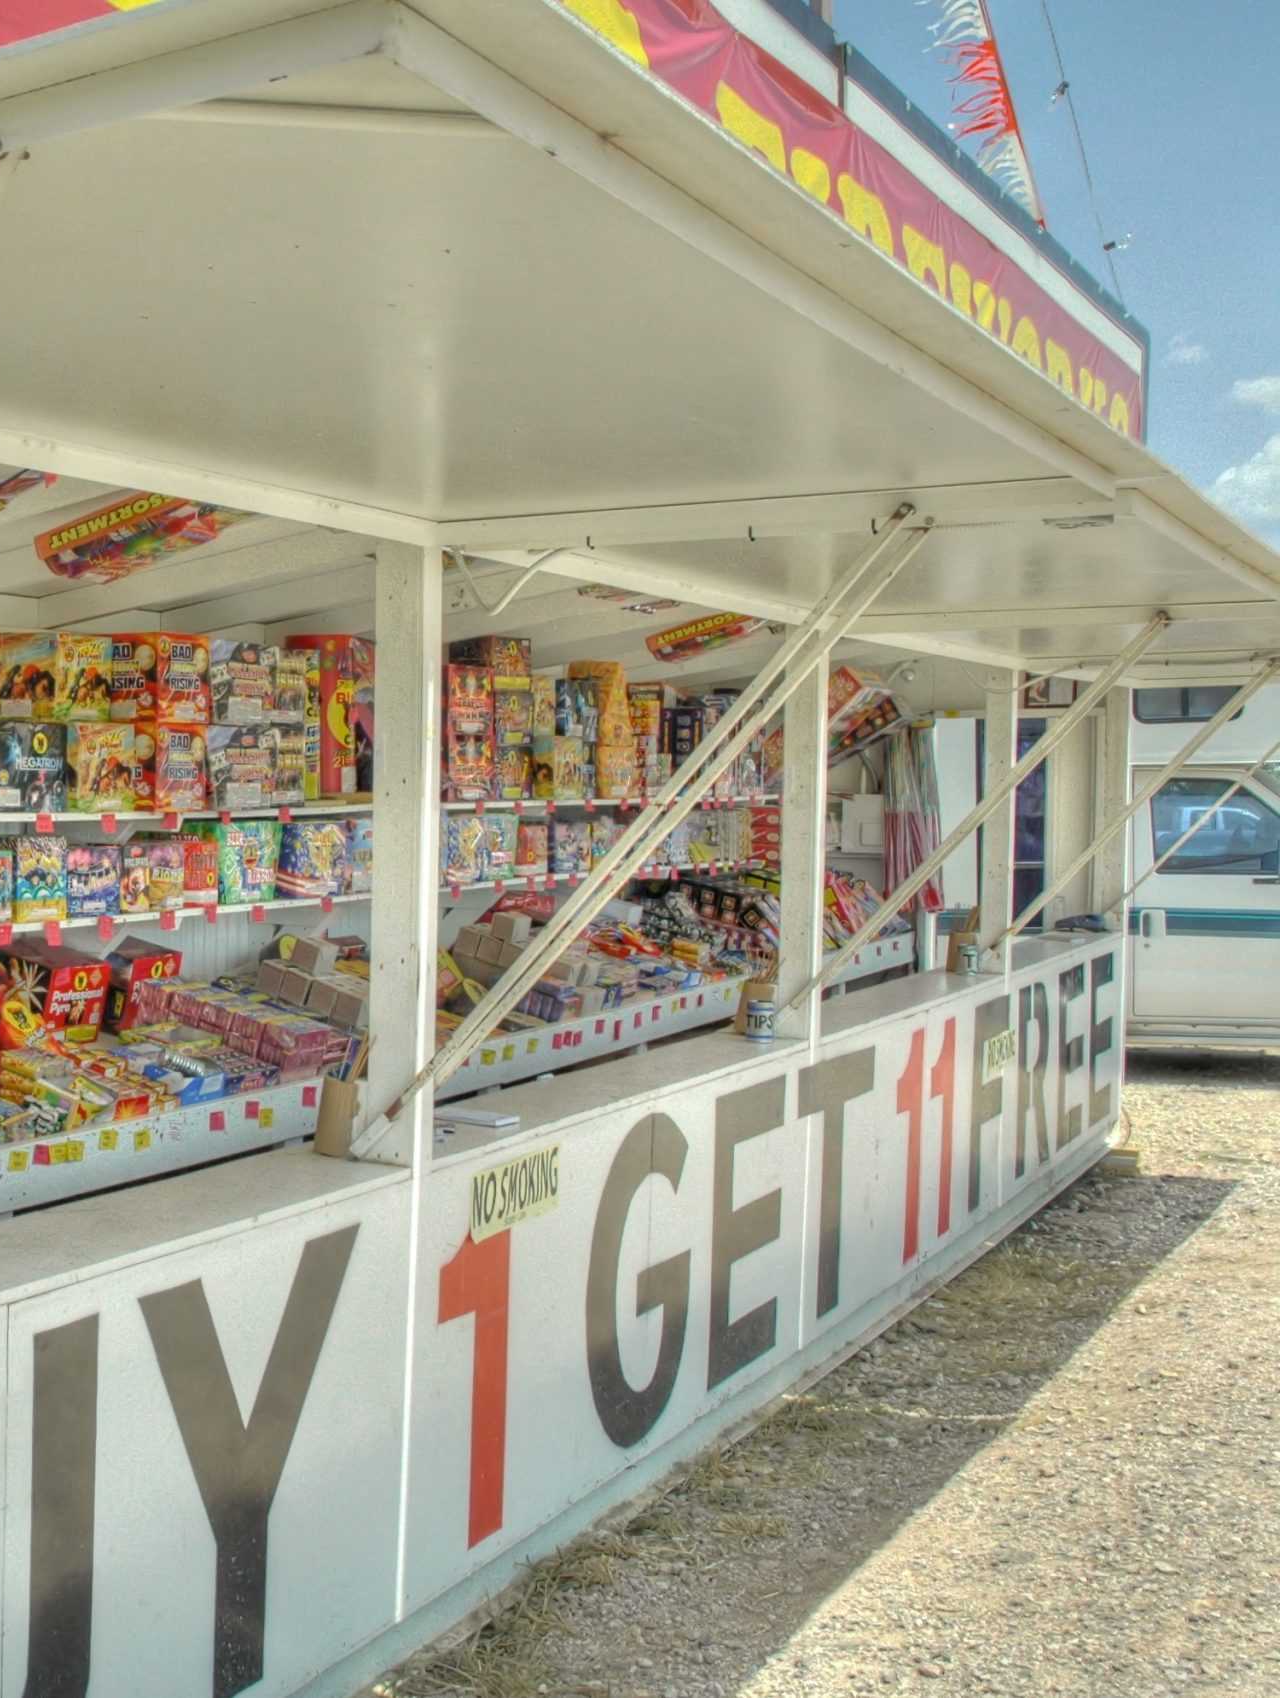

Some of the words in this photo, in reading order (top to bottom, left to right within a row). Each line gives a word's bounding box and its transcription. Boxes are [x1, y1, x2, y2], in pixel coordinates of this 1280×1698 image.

[172, 645, 192, 658] BAD
[170, 677, 199, 690] RISING
[170, 735, 189, 748] BAD
[169, 767, 198, 780] RISING
[52, 986, 104, 1003] Professional
[747, 1014, 775, 1029] TIPS
[472, 1171, 497, 1230] NO
[497, 1146, 559, 1219] SMOKING
[436, 1229, 513, 1550] 1
[585, 1045, 877, 1449] GET
[896, 1016, 957, 1265] 11
[967, 951, 1114, 1213] FREE
